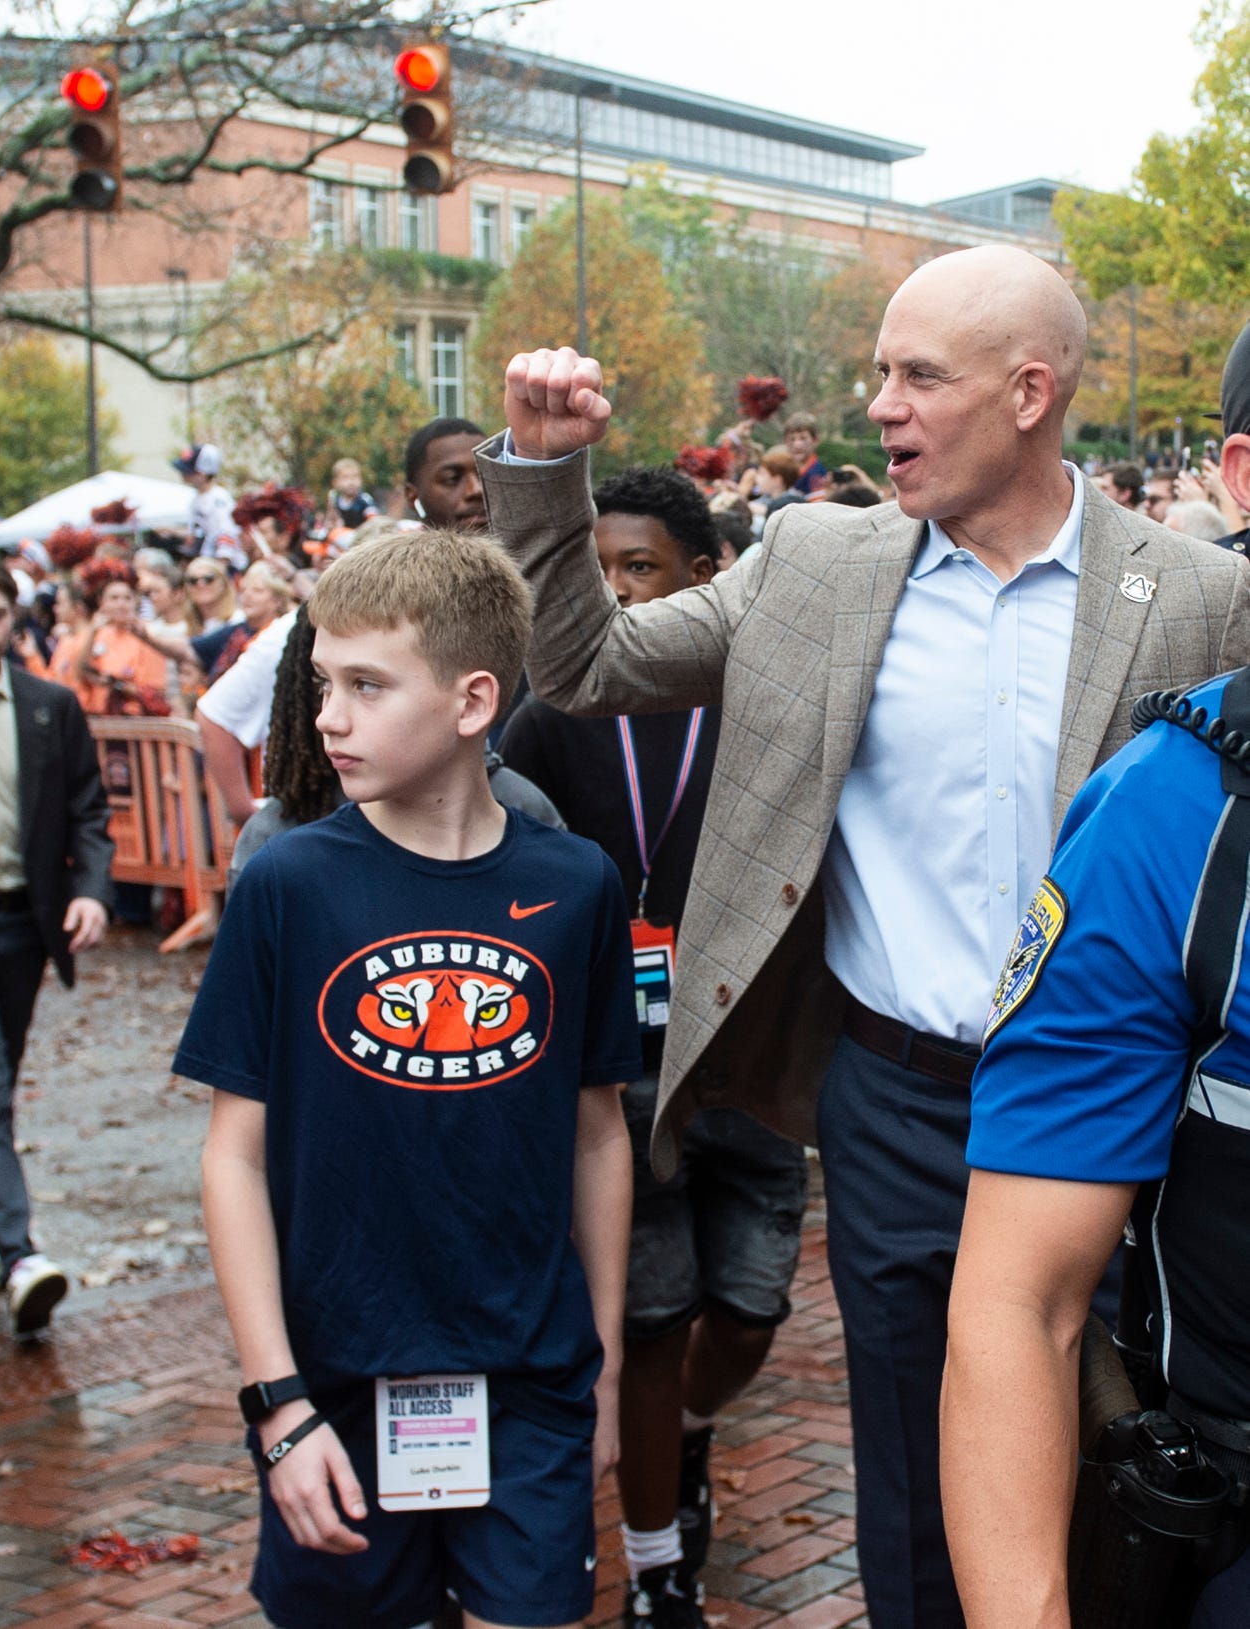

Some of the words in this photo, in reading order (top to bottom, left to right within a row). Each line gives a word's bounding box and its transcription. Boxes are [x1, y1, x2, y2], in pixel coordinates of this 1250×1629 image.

[364, 942, 530, 982] AUBURN
[350, 1030, 538, 1079] TIGERS
[387, 1383, 441, 1400] WORKING
[443, 1381, 474, 1398] STAFF
[388, 1400, 407, 1416] ALL
[409, 1399, 453, 1416] ACCESS
